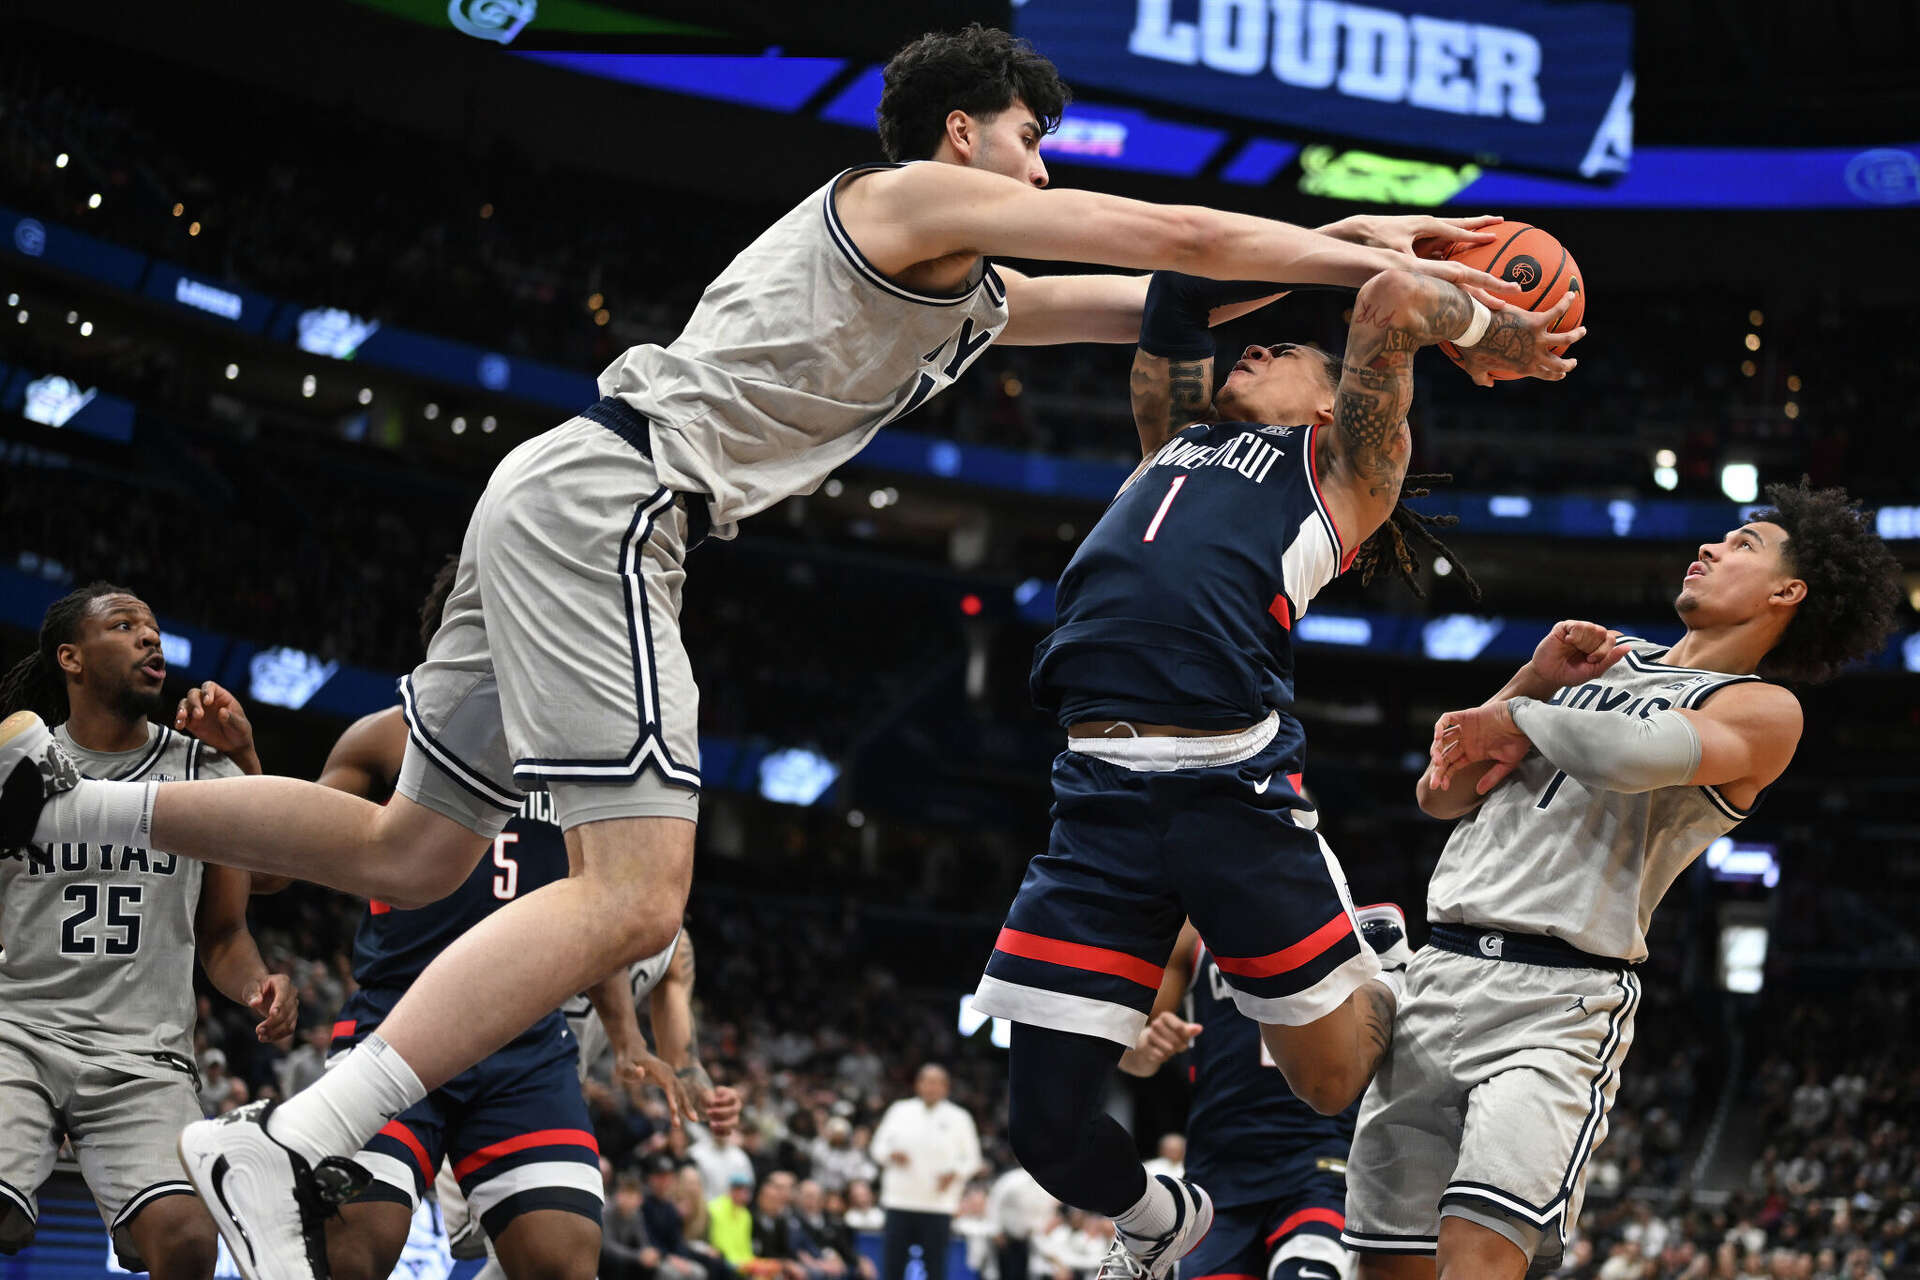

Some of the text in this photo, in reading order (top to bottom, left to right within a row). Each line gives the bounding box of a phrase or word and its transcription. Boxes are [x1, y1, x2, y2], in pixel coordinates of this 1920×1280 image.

[1128, 0, 1545, 124] LOUDER
[1142, 474, 1188, 542] 1
[493, 832, 519, 900] 5
[60, 883, 143, 955] 25
